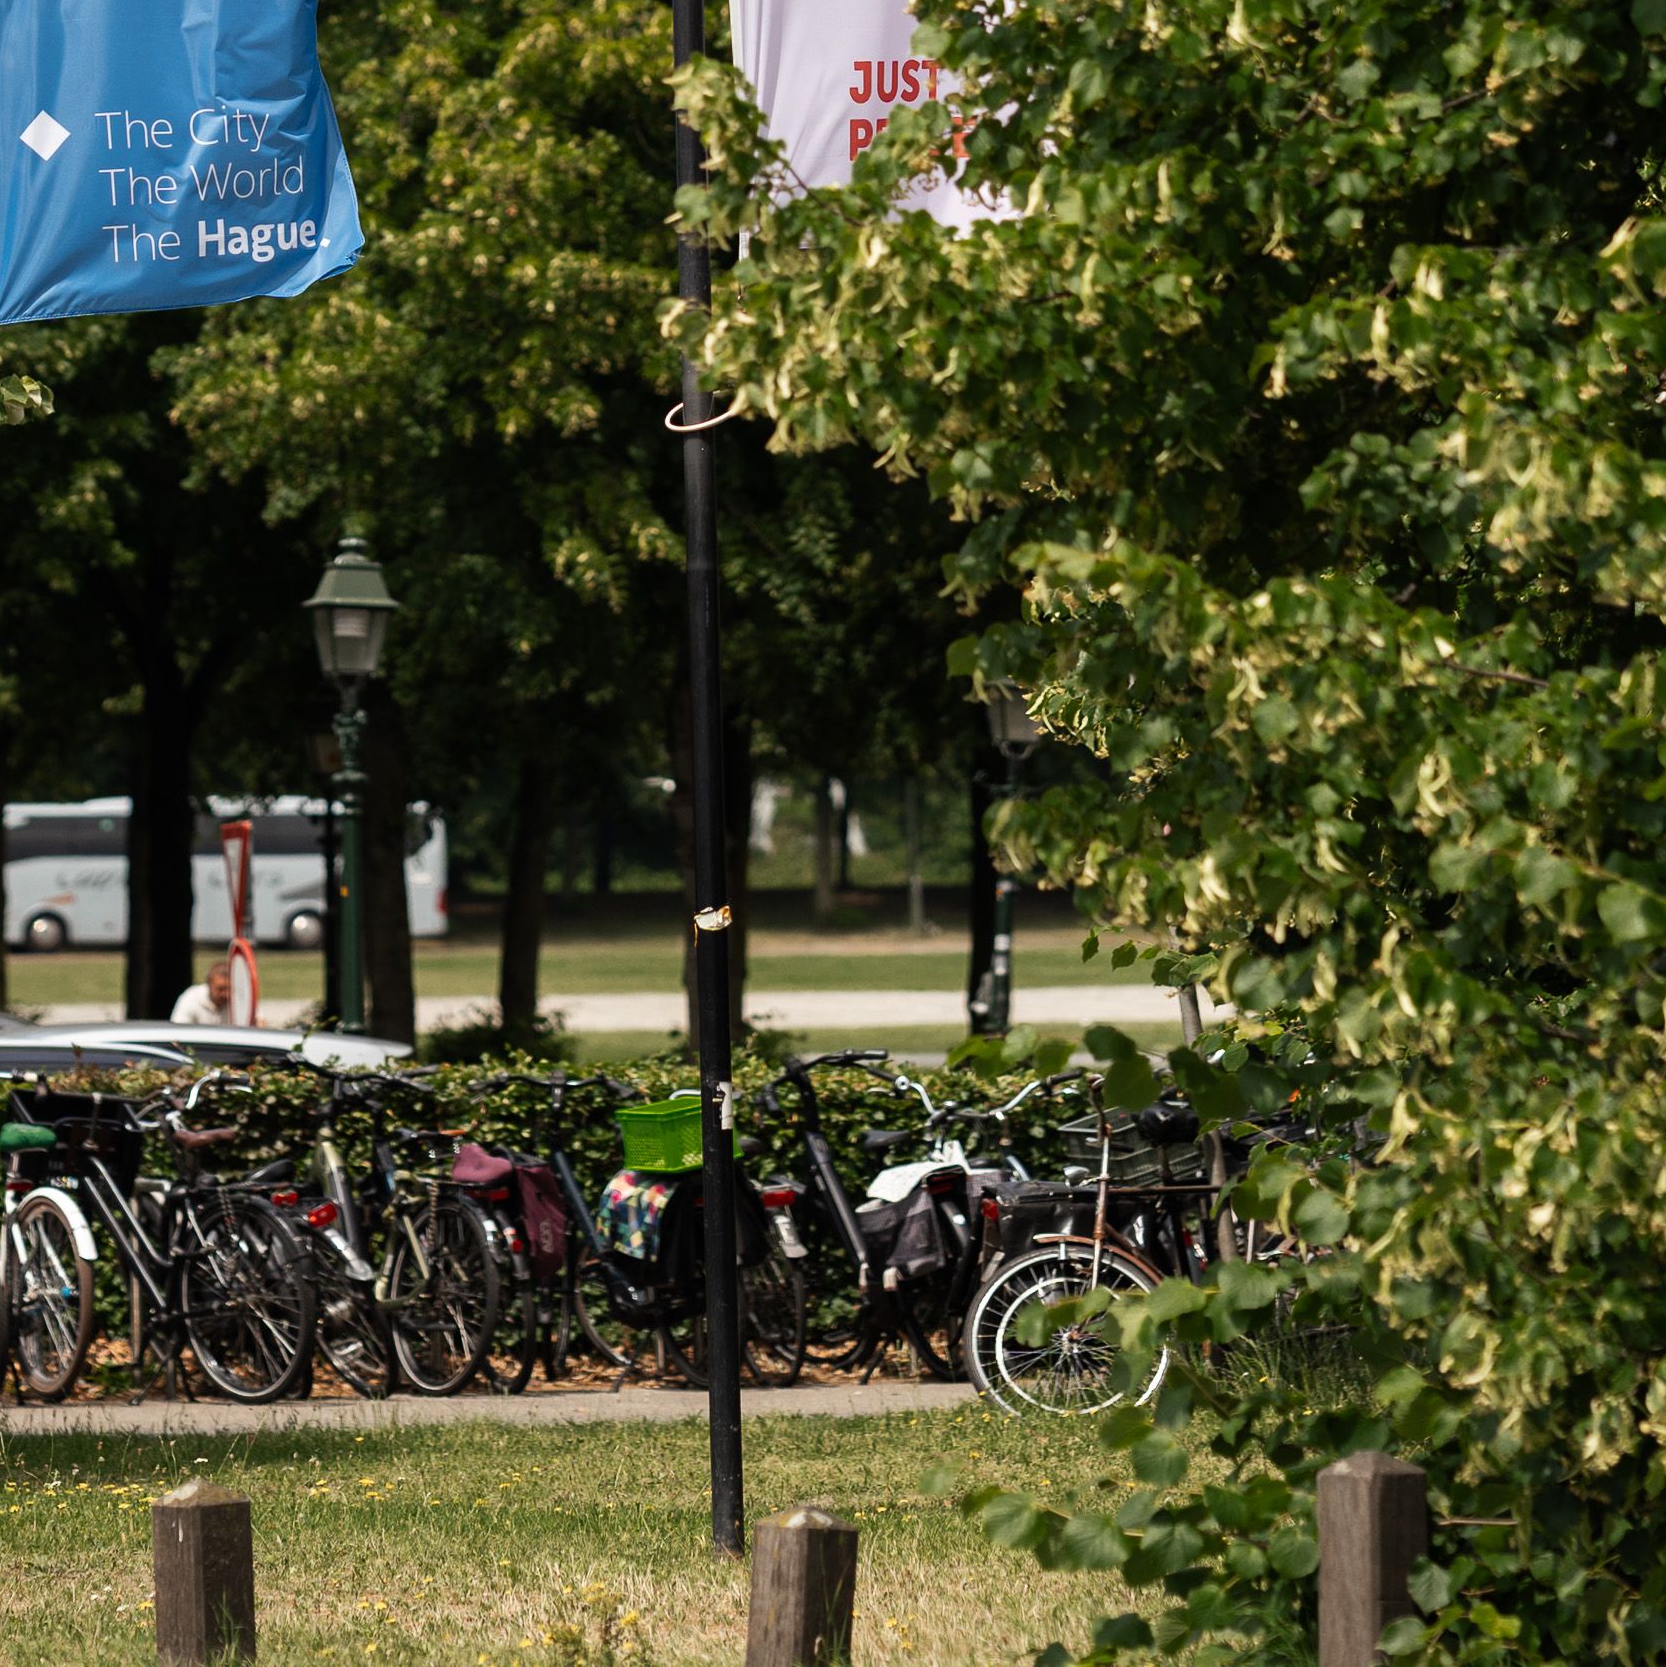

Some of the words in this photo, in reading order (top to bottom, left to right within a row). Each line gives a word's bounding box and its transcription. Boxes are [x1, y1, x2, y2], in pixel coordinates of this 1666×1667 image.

[849, 59, 941, 104] JUST
[94, 110, 173, 150] The
[189, 105, 270, 153] City
[99, 166, 178, 206] The
[190, 155, 303, 201] World
[102, 224, 181, 263] The
[197, 218, 317, 263] Hague
